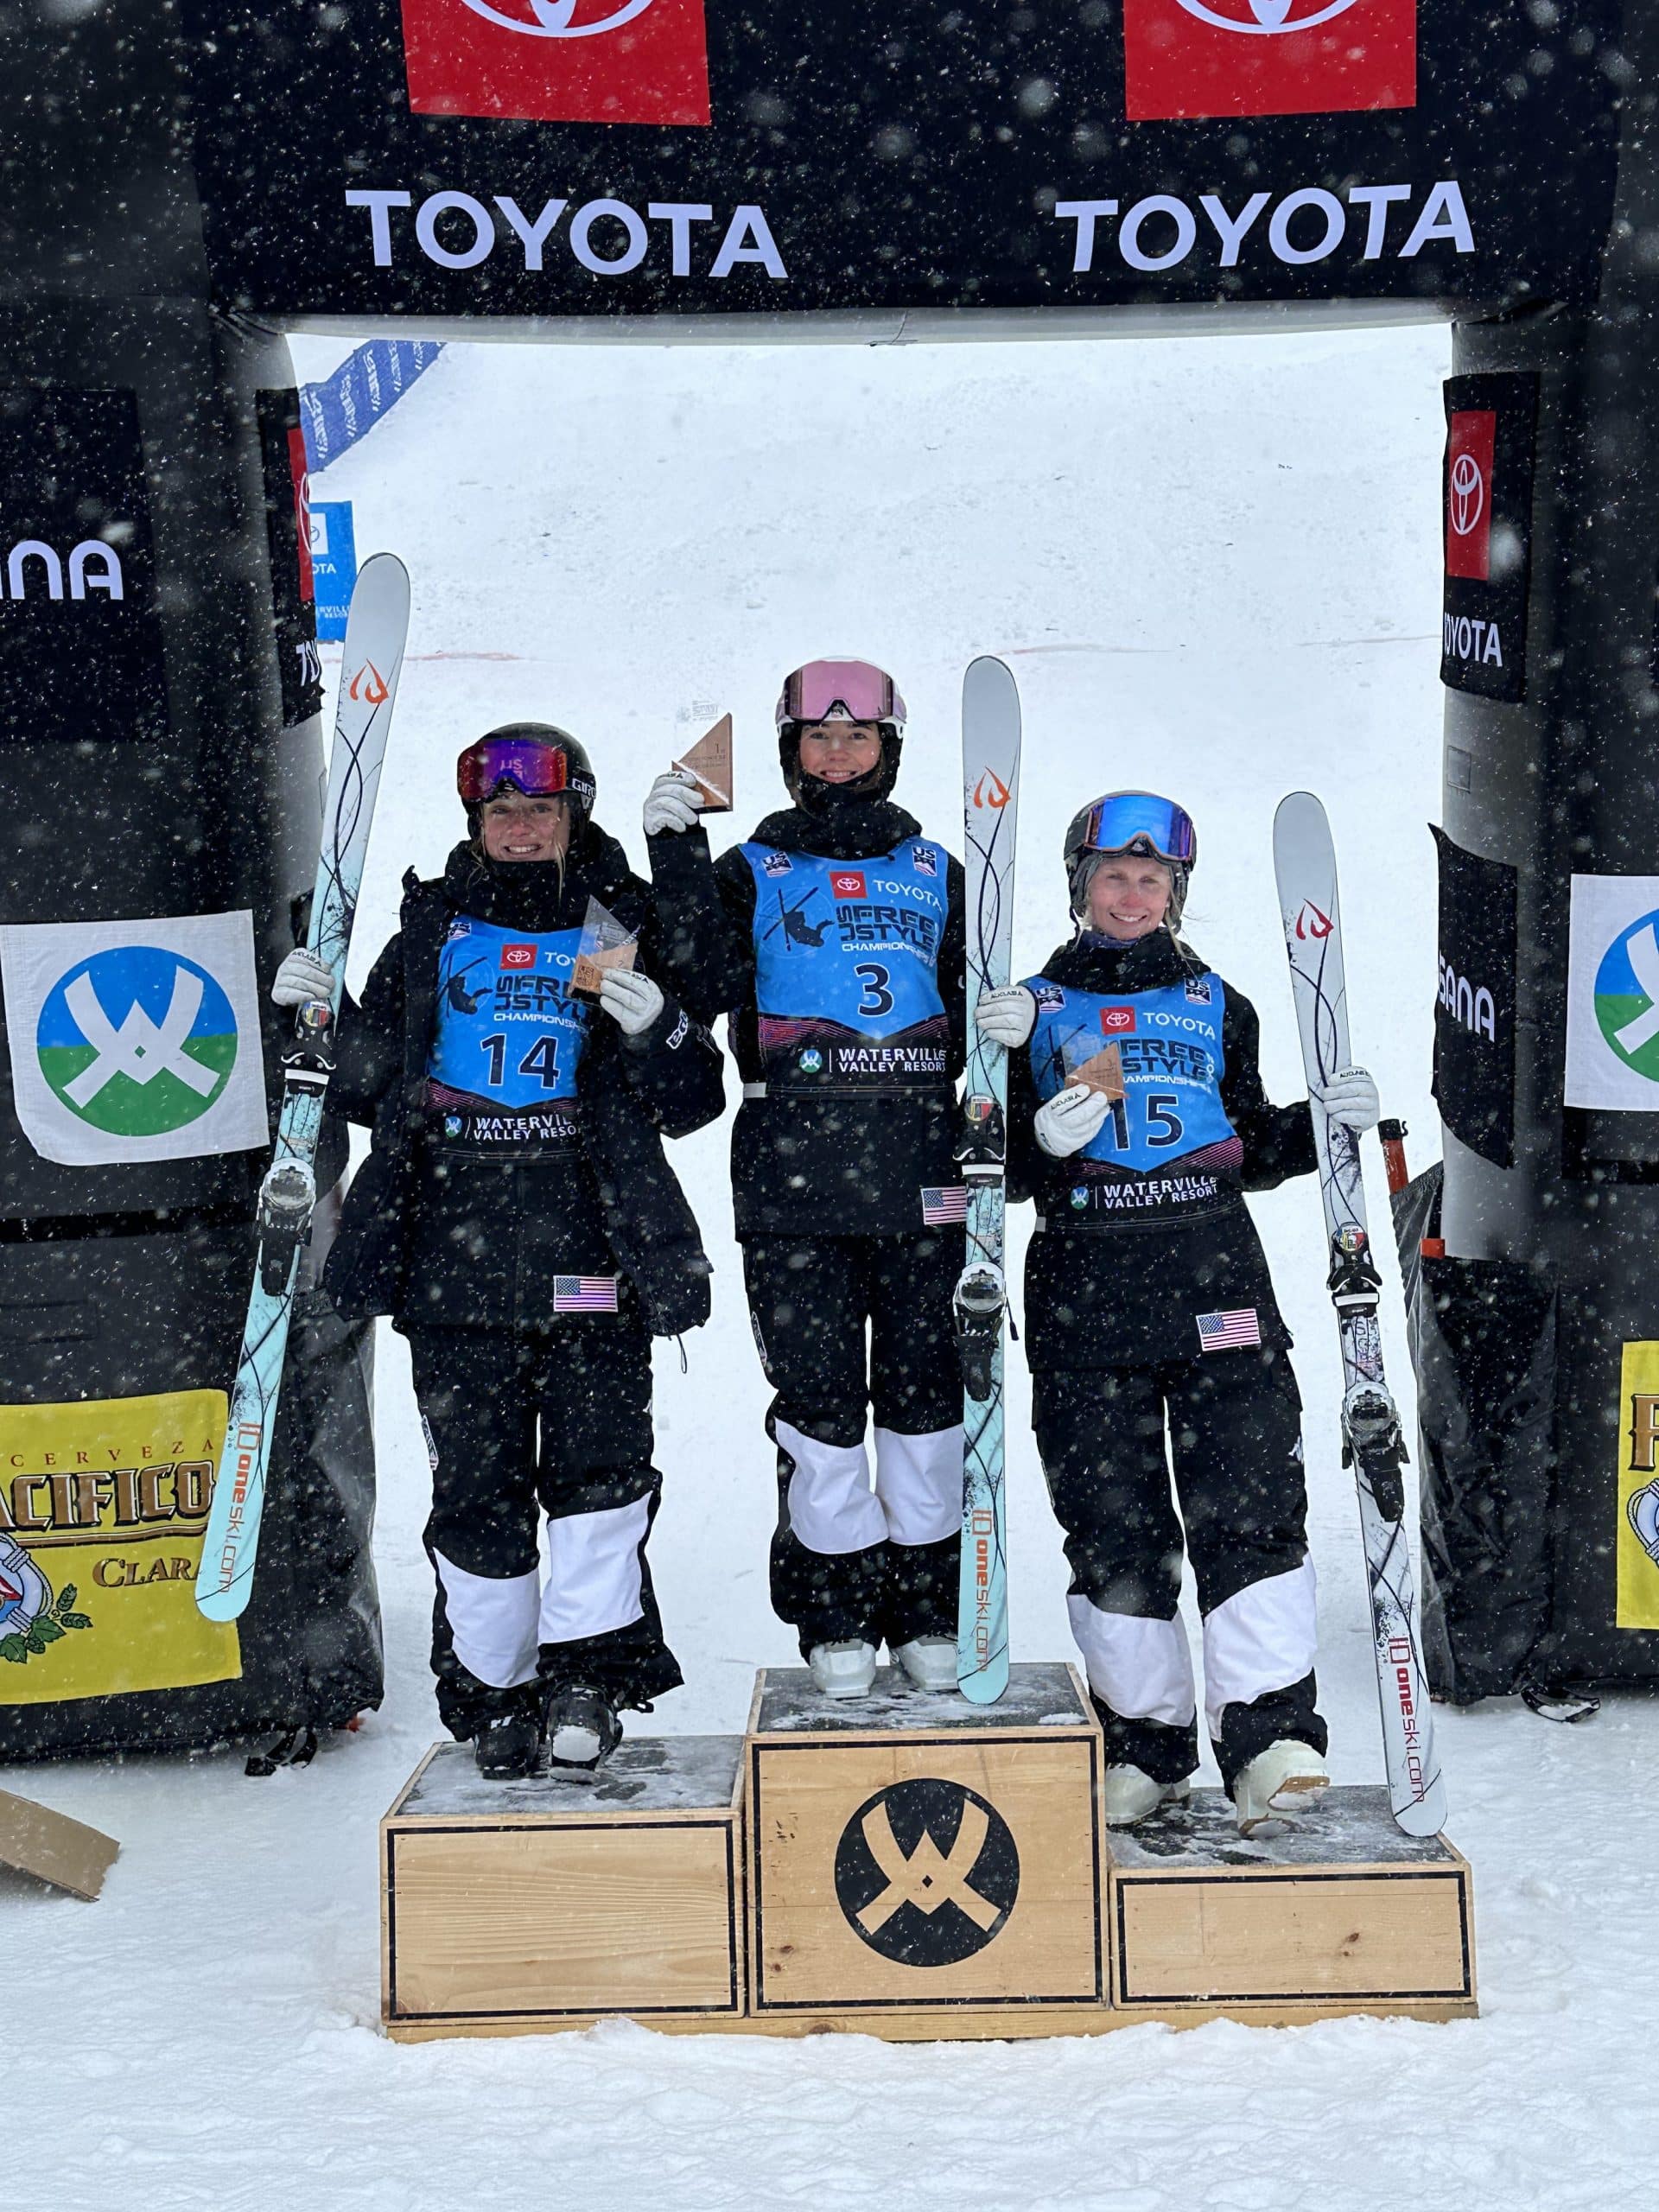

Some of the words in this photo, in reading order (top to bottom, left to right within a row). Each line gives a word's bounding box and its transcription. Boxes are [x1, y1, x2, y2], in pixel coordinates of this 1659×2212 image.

[345, 189, 789, 280] TOYOTA
[1053, 180, 1476, 272] TOYOTA
[912, 846, 936, 859] US
[873, 879, 943, 912] TOYOTA
[854, 962, 894, 1018] 3
[512, 994, 586, 1020] STYL
[1142, 1012, 1216, 1040] TOYOTA
[480, 1033, 561, 1090] 14
[838, 1047, 947, 1062] WATERVILLE
[838, 1061, 896, 1072] VALLEY
[473, 1129, 531, 1141] VALLEY
[539, 1125, 578, 1140] RESO
[475, 1114, 572, 1129] WATERVIL
[1112, 1093, 1185, 1151] 15
[1103, 1176, 1218, 1199] WATERVILLE
[1104, 1194, 1162, 1209] VALLEY
[1172, 1184, 1218, 1203] RESORT
[10, 1439, 214, 1467] CERVEZA
[0, 1460, 216, 1533] CIFICO
[92, 1557, 200, 1587] CLAR
